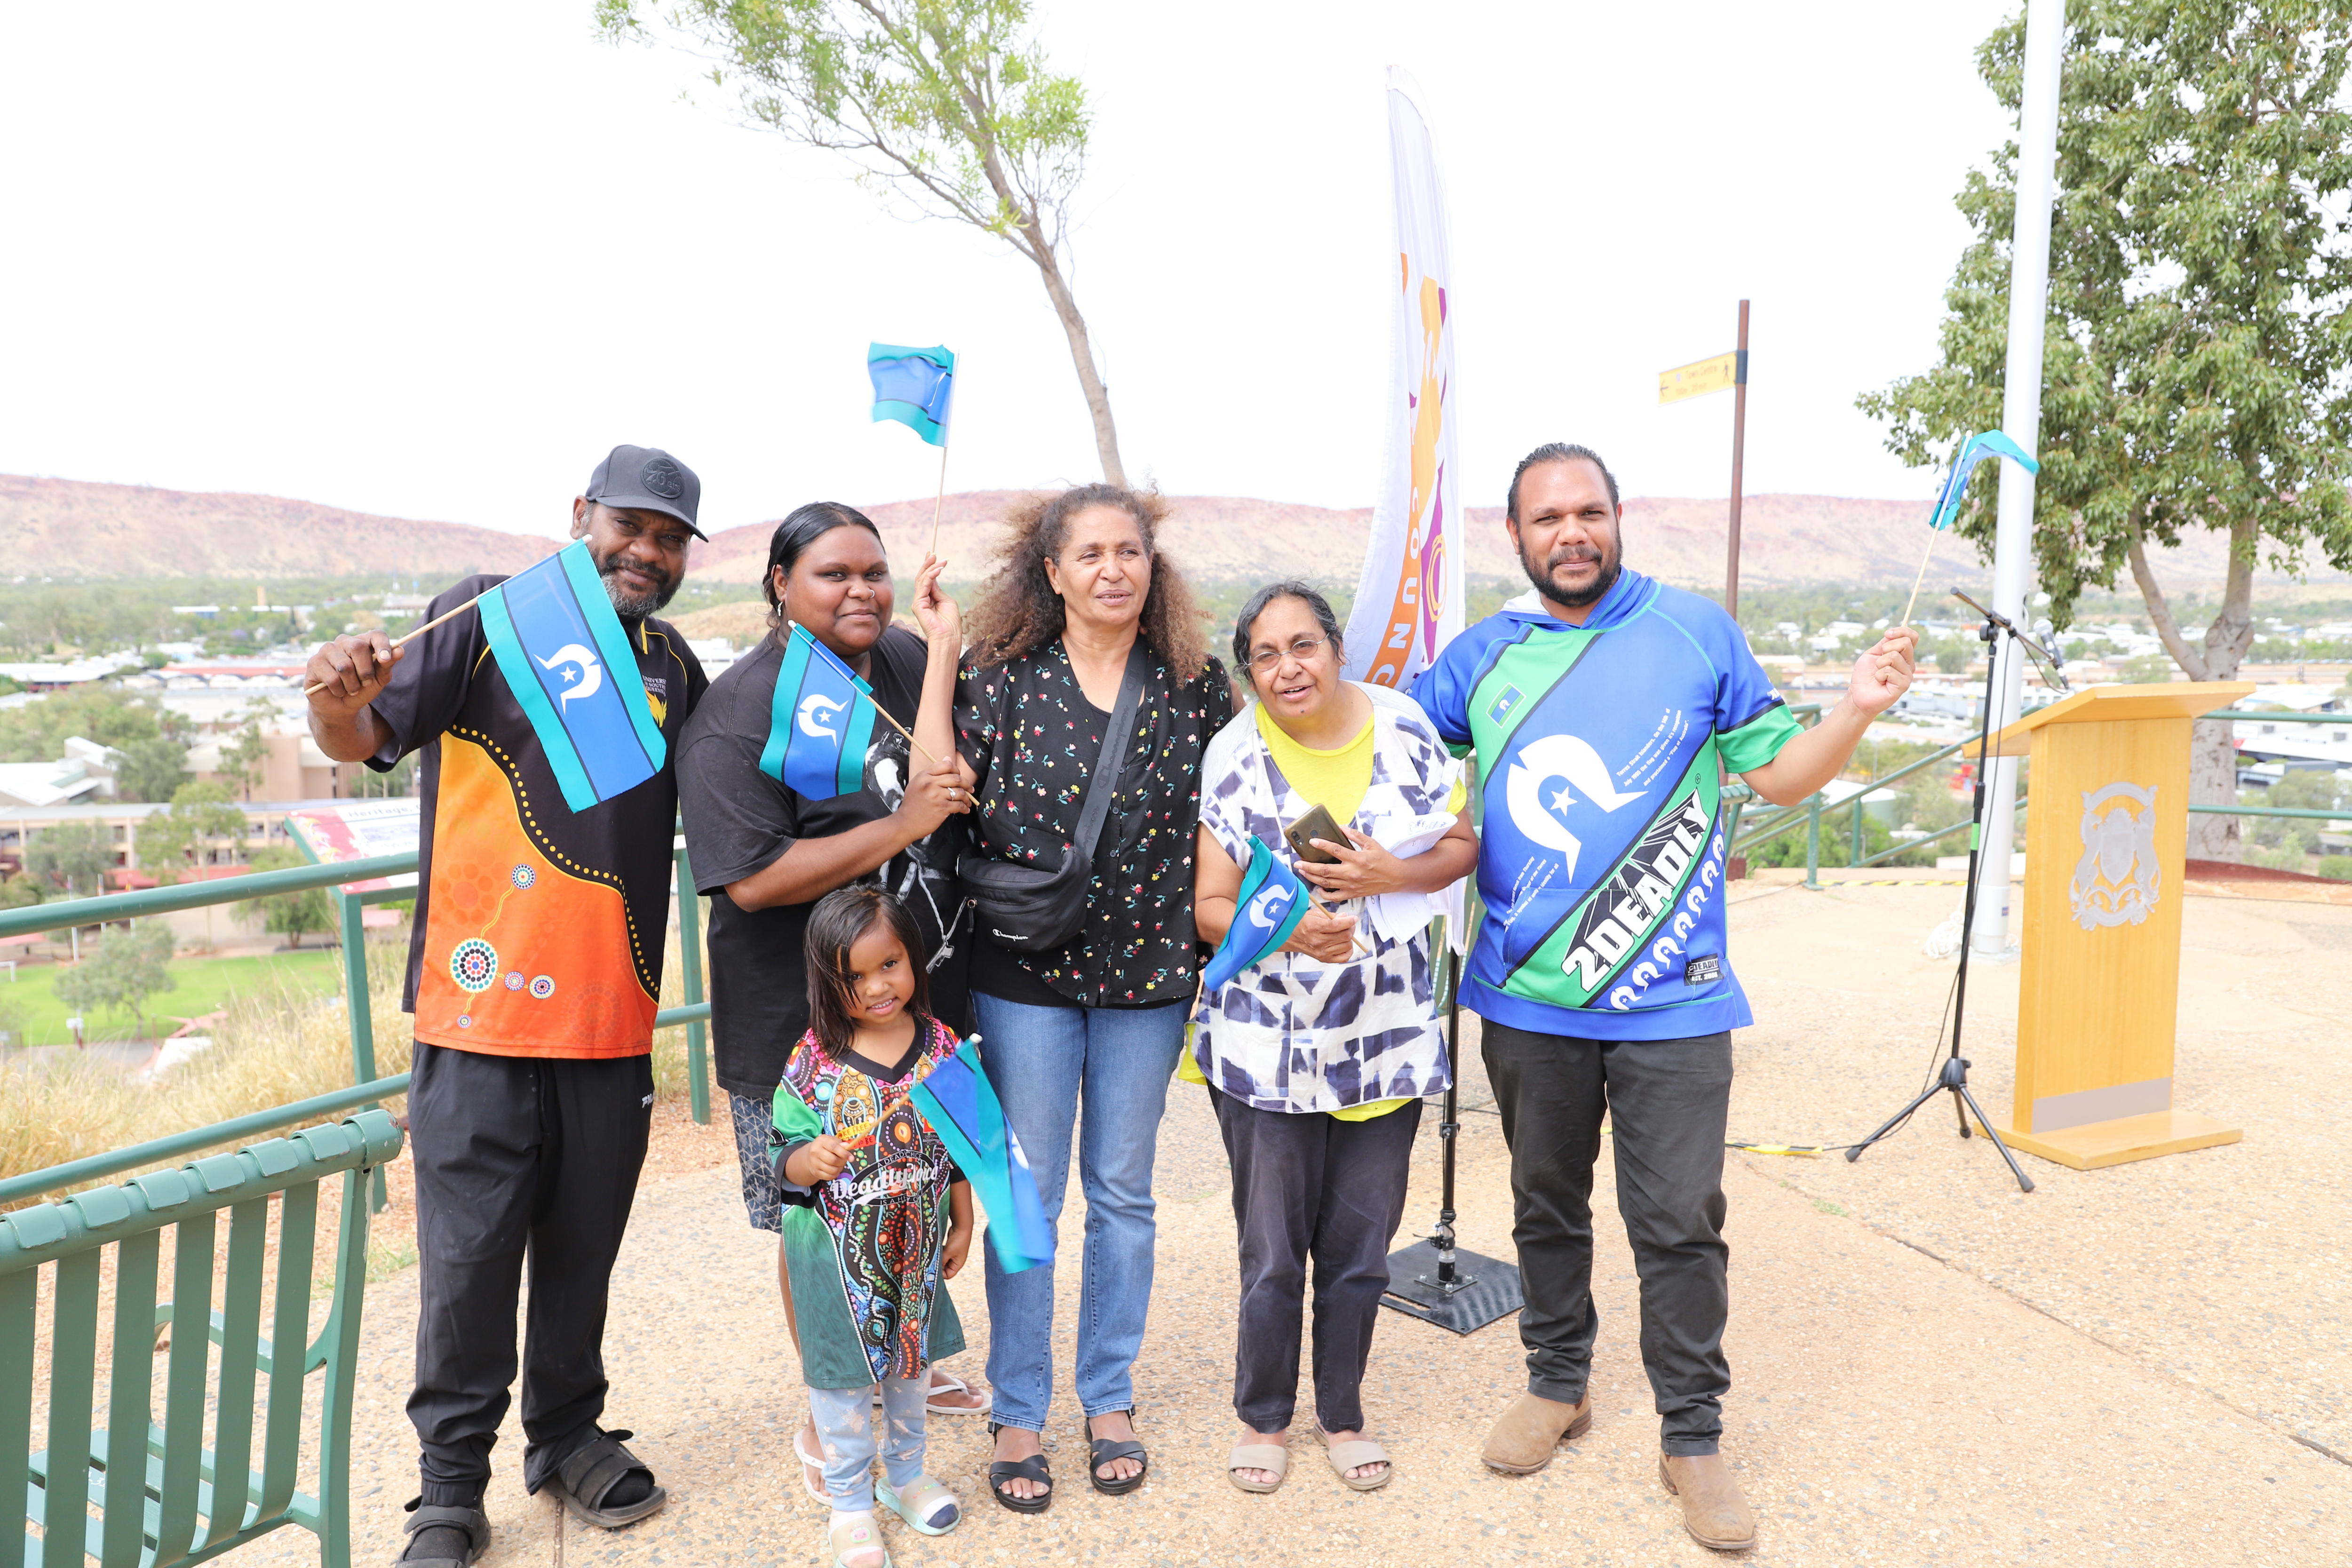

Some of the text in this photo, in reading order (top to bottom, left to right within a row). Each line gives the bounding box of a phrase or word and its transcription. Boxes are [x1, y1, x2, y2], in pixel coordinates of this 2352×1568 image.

[1616, 764, 1630, 777] Torres
[1629, 755, 1640, 766] Strait
[1638, 739, 1655, 756] Islanders.
[1623, 778, 1632, 787] July
[1646, 757, 1655, 765] flag
[1660, 739, 1669, 750] given
[1650, 759, 1668, 780] proclaimed
[1561, 787, 1709, 993] 2DEADLY
[1517, 900, 1528, 913] symbol
[992, 928, 1029, 942] Champion
